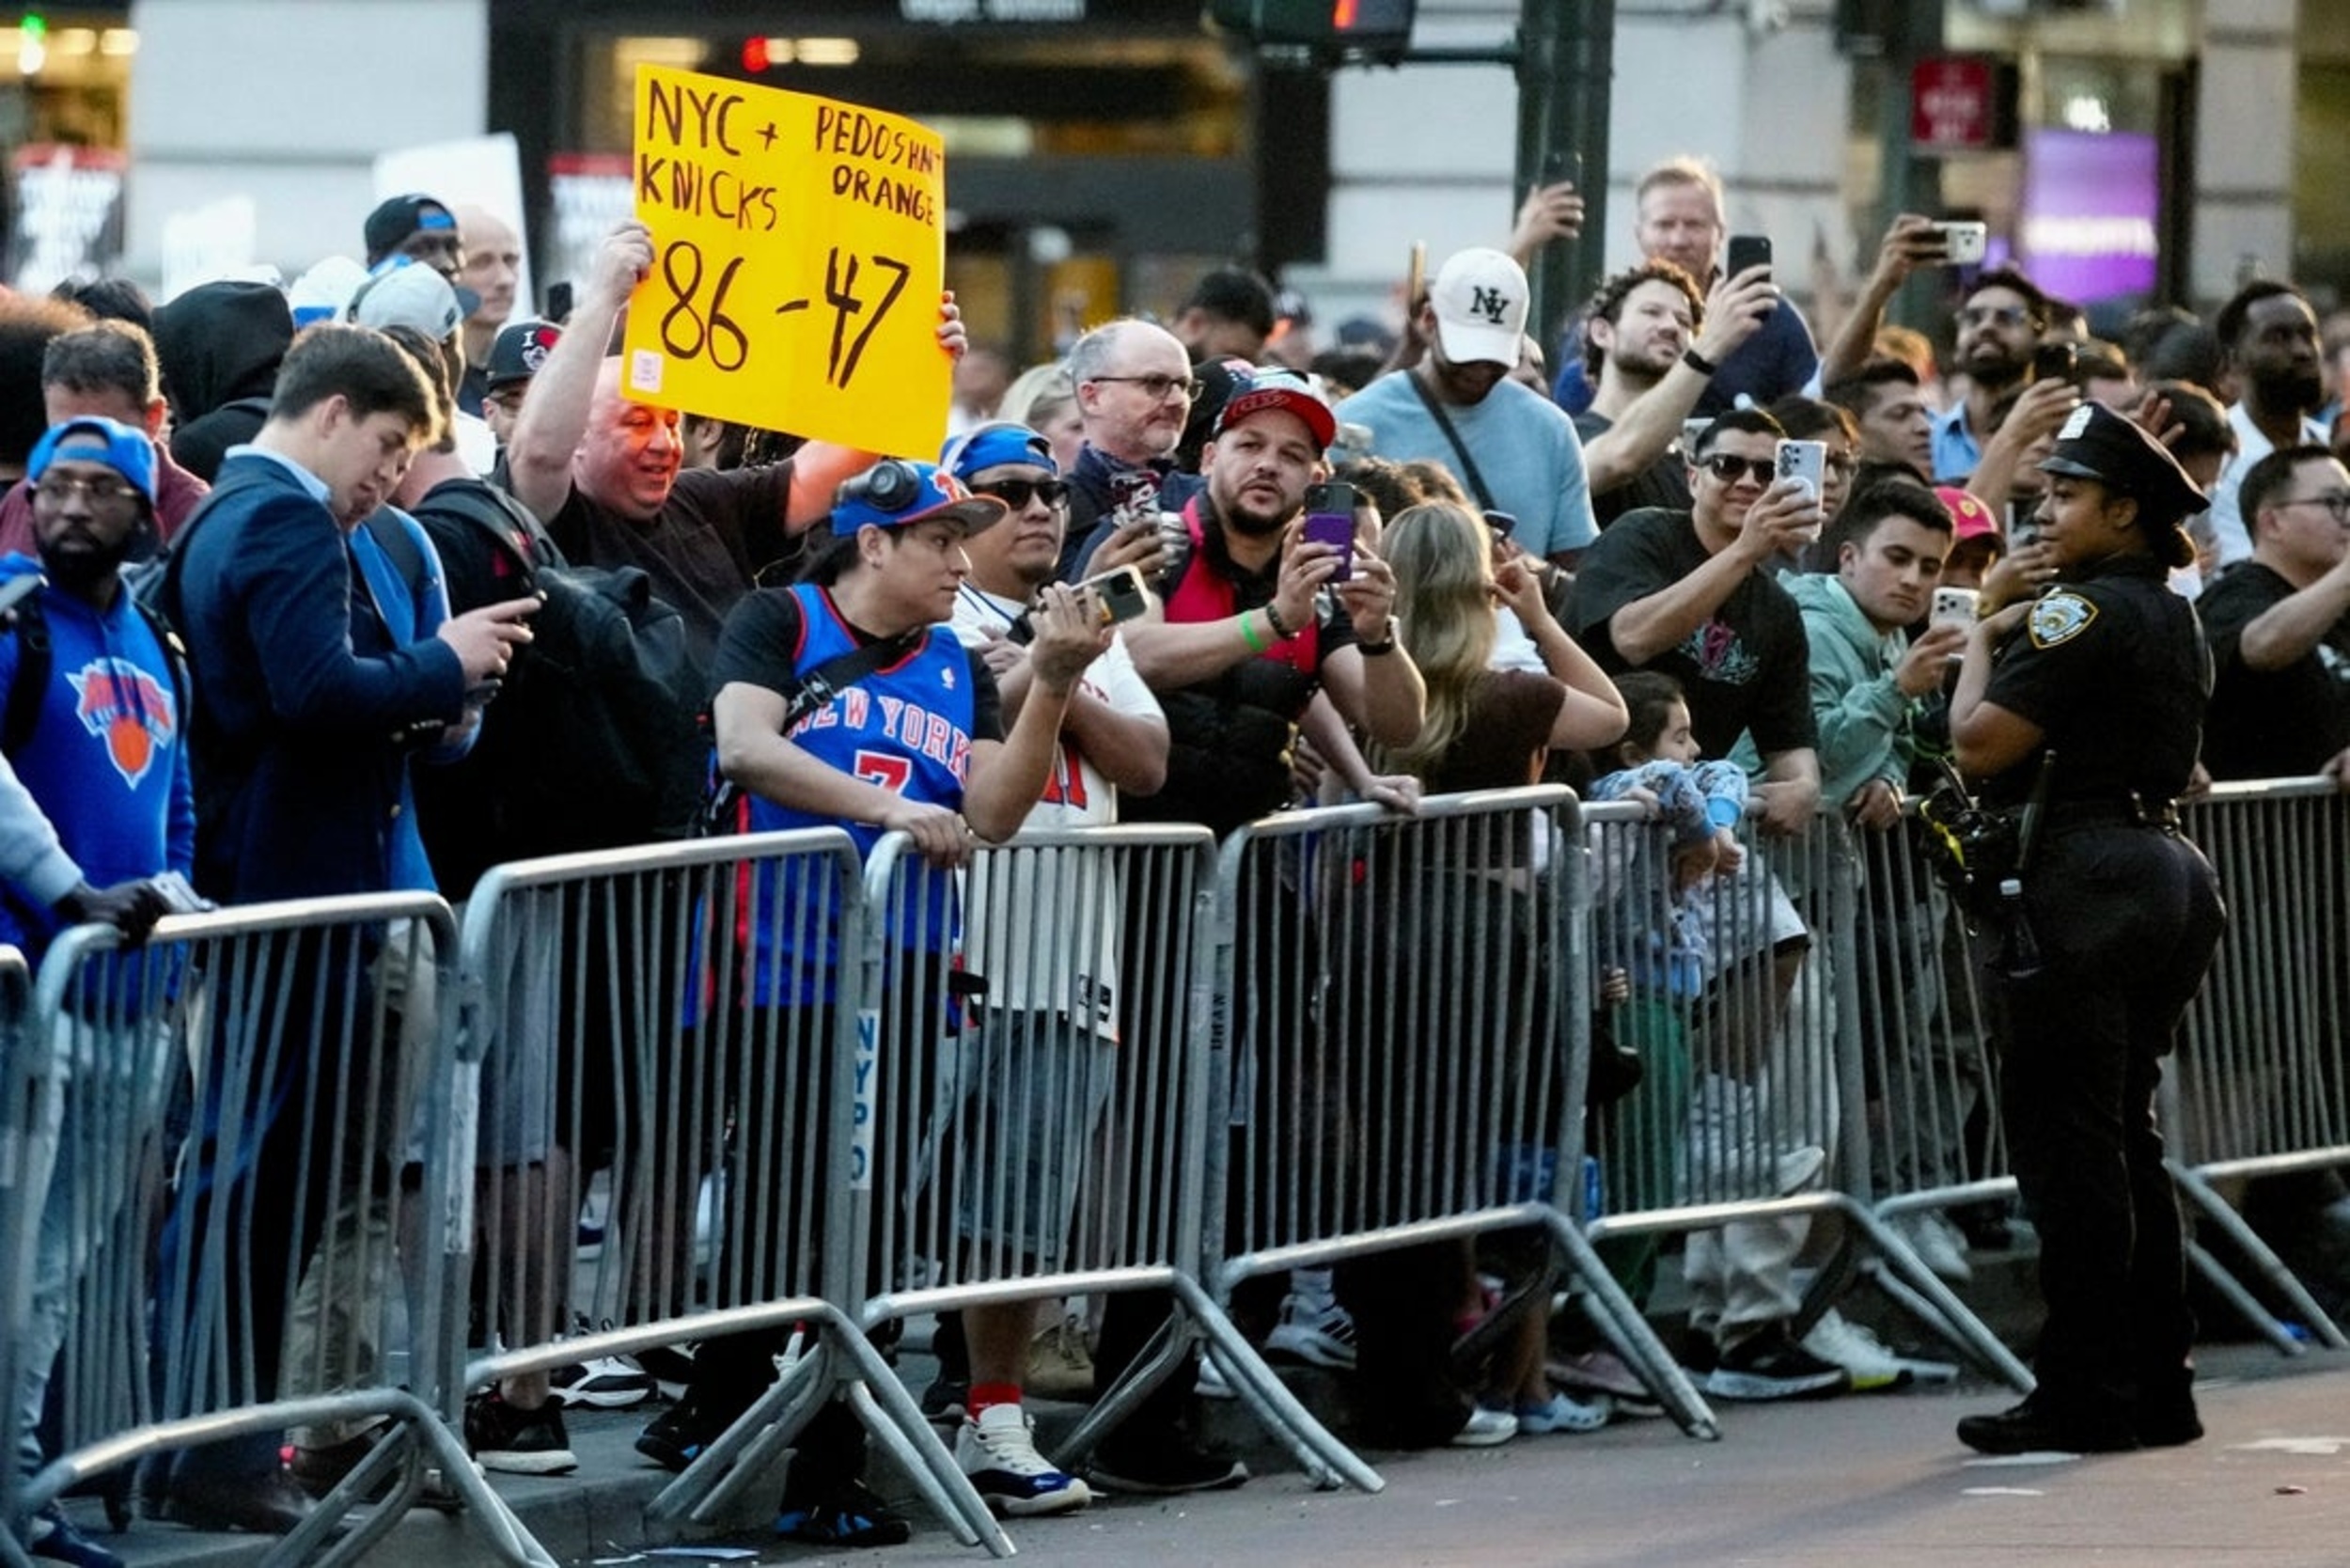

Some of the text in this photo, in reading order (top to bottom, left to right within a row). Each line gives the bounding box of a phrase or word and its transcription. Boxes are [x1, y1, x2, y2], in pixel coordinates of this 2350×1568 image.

[648, 79, 745, 156] NYC
[640, 153, 777, 231] KNICKS
[833, 165, 933, 227] ORANGE
[661, 241, 748, 371] 86
[1469, 285, 1511, 325] NY
[854, 749, 913, 797] 7
[878, 695, 972, 791] YORK
